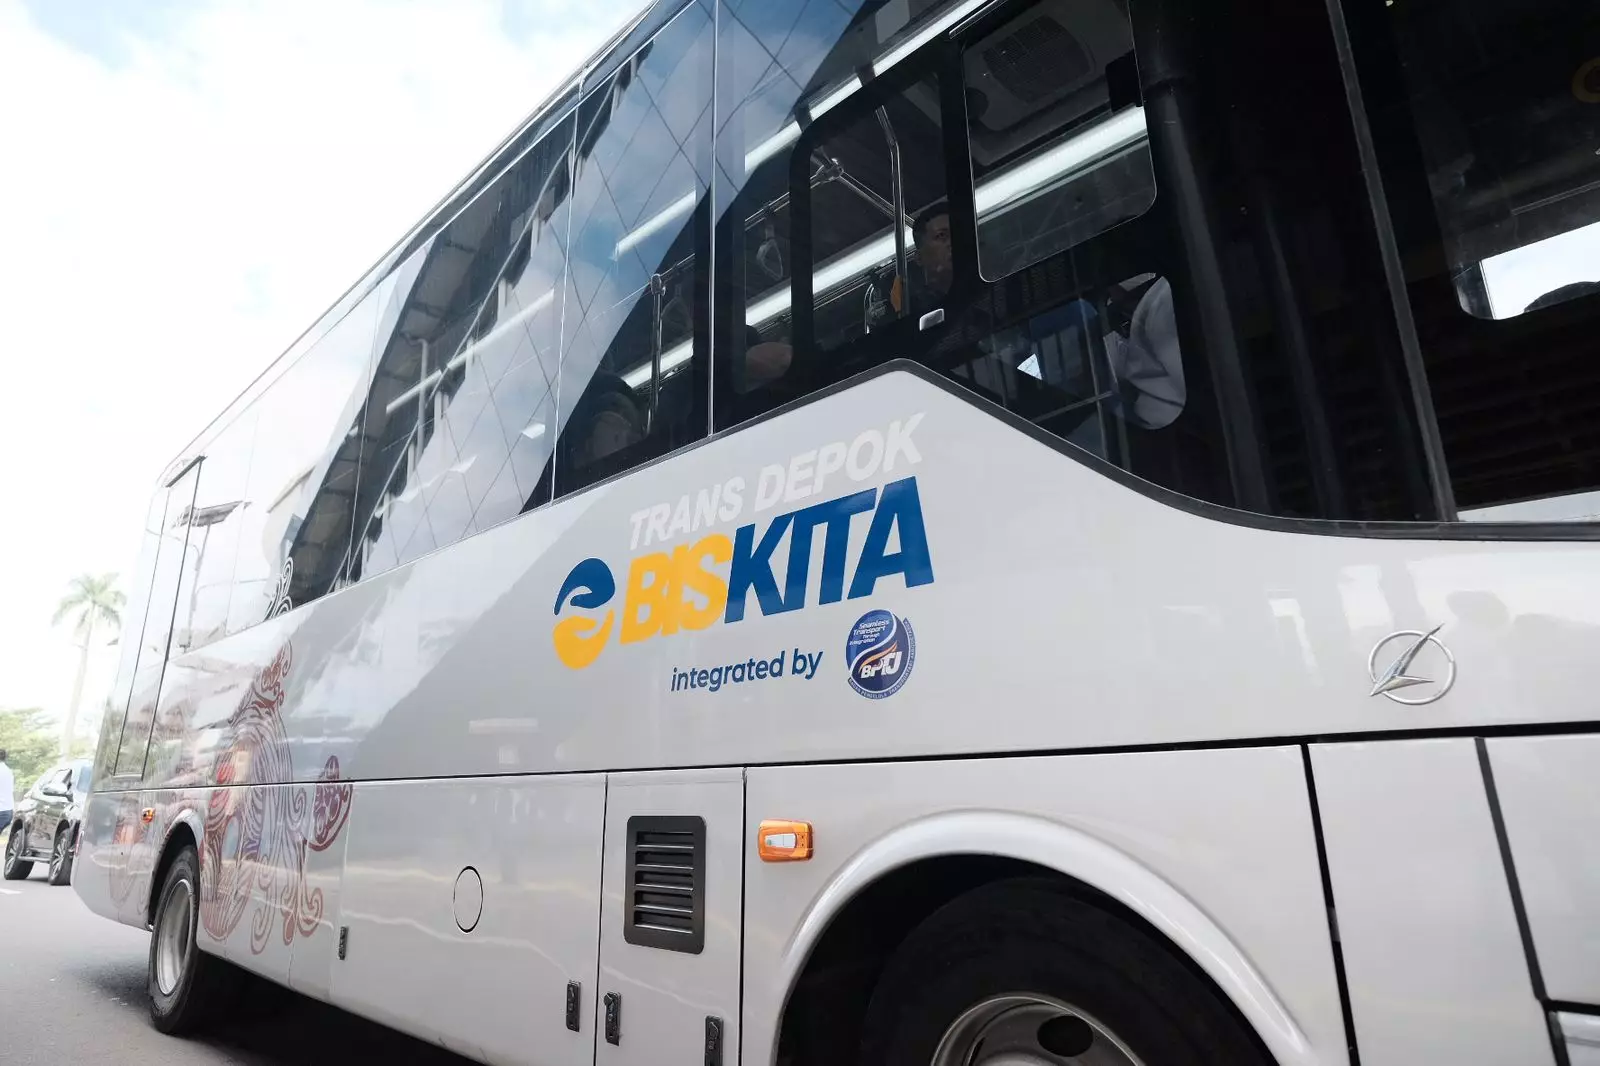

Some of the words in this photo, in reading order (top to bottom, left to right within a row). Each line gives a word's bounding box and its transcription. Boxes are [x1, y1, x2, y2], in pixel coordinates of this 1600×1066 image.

[629, 481, 744, 551] TRANS
[754, 412, 927, 509] DEPOK
[620, 476, 934, 645] BISKITA
[853, 626, 886, 636] Transport
[671, 650, 785, 692] integrated
[791, 648, 823, 679] by
[860, 651, 902, 679] BPTJ
